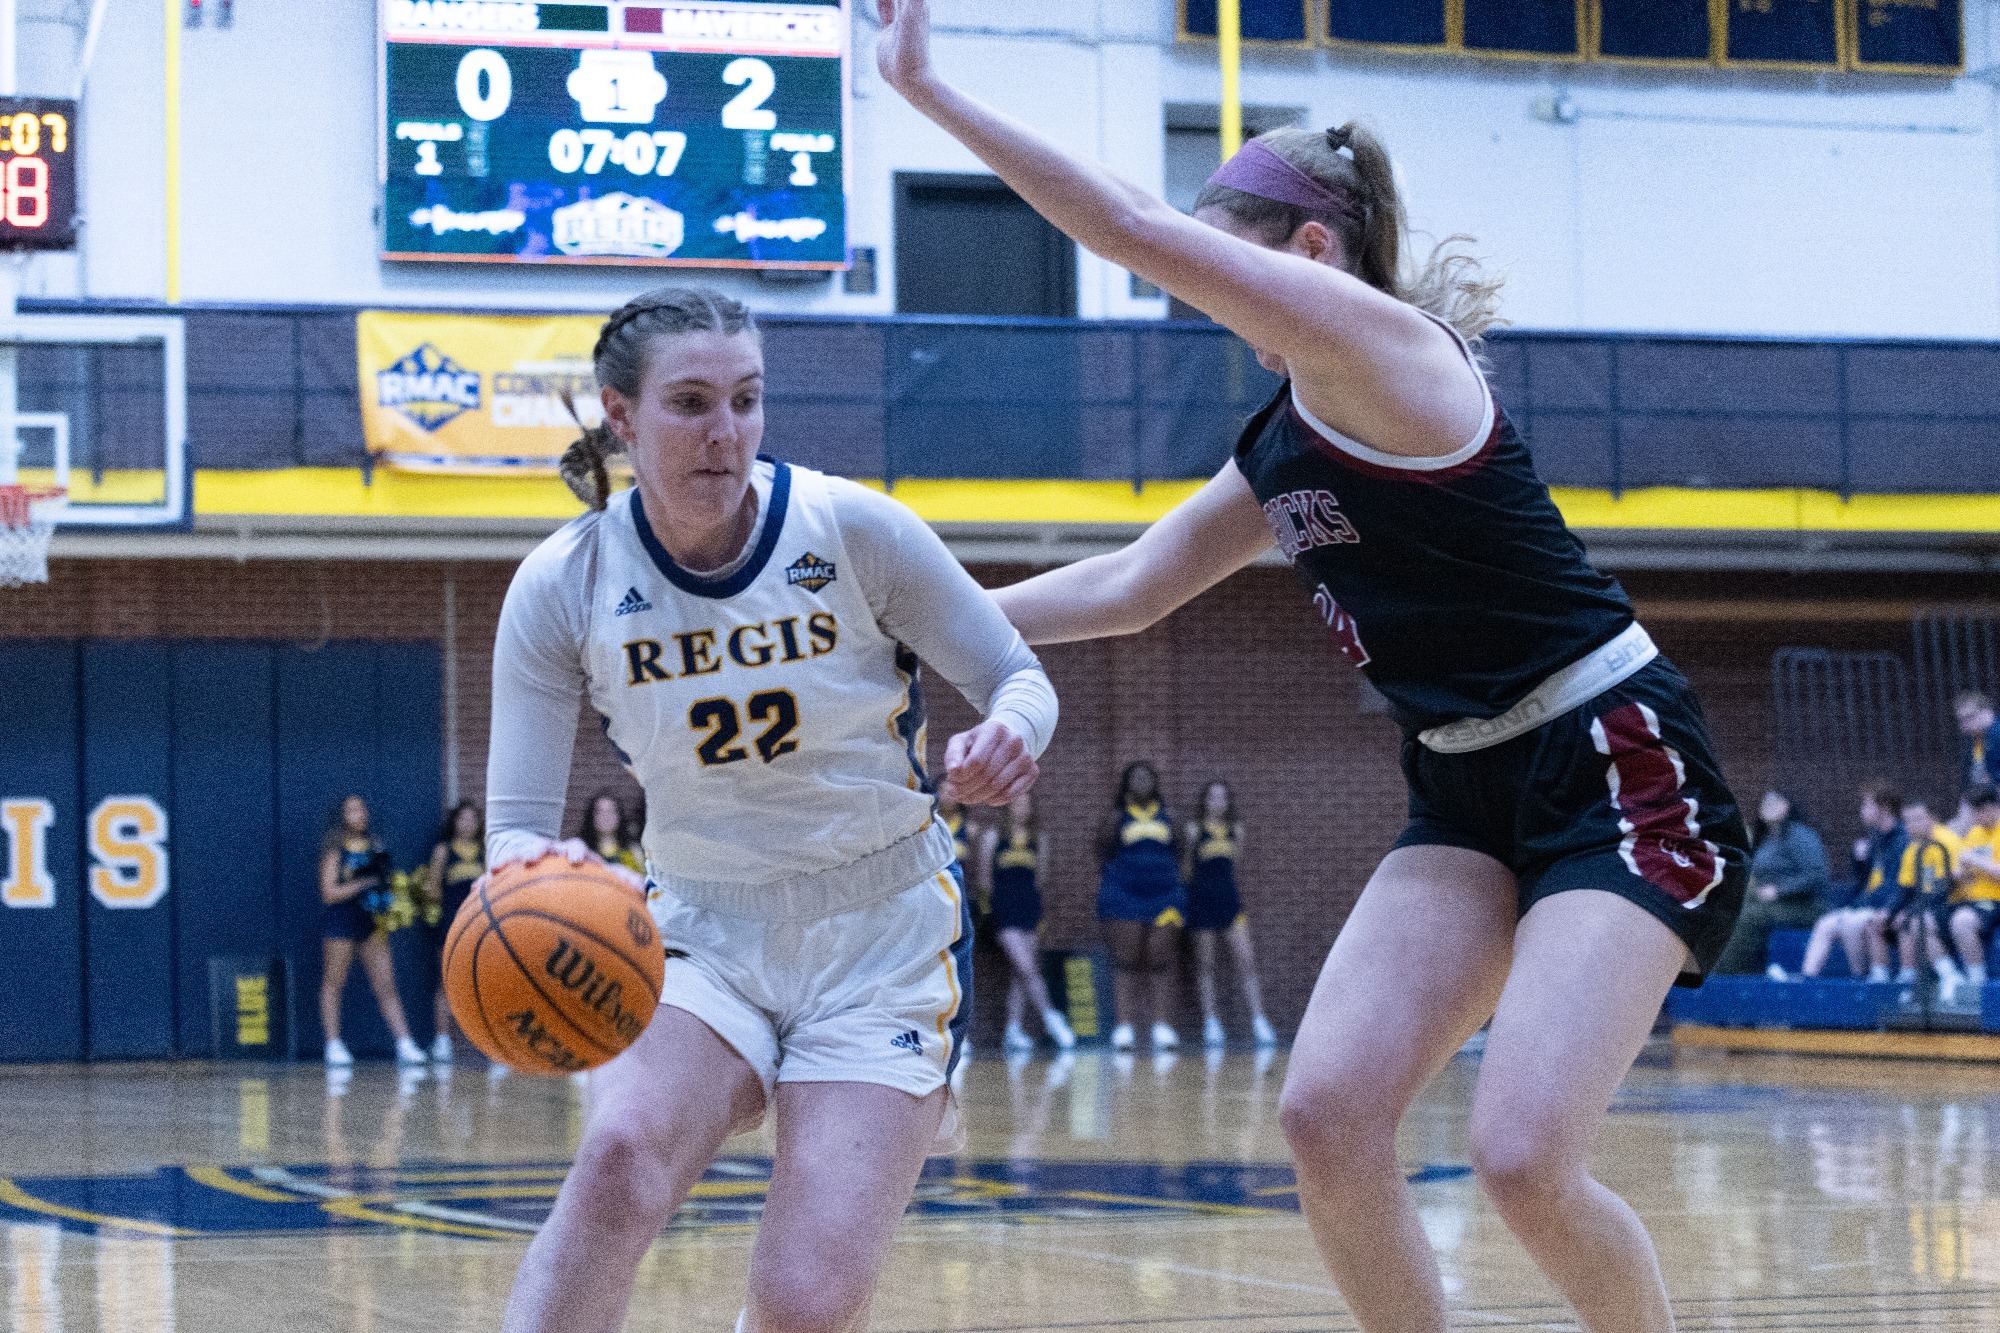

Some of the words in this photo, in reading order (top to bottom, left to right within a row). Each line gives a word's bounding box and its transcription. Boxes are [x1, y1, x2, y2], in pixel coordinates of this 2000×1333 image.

[664, 10, 836, 41] MAVERICKS
[456, 48, 512, 122] 0
[721, 57, 777, 130] 2
[414, 141, 443, 176] 1
[548, 128, 686, 177] 07:07
[790, 152, 817, 186] 1
[0, 156, 48, 227] 8
[378, 372, 479, 406] RMAC
[789, 565, 835, 582] RMAC
[622, 611, 839, 687] REGIS
[687, 687, 800, 767] 22
